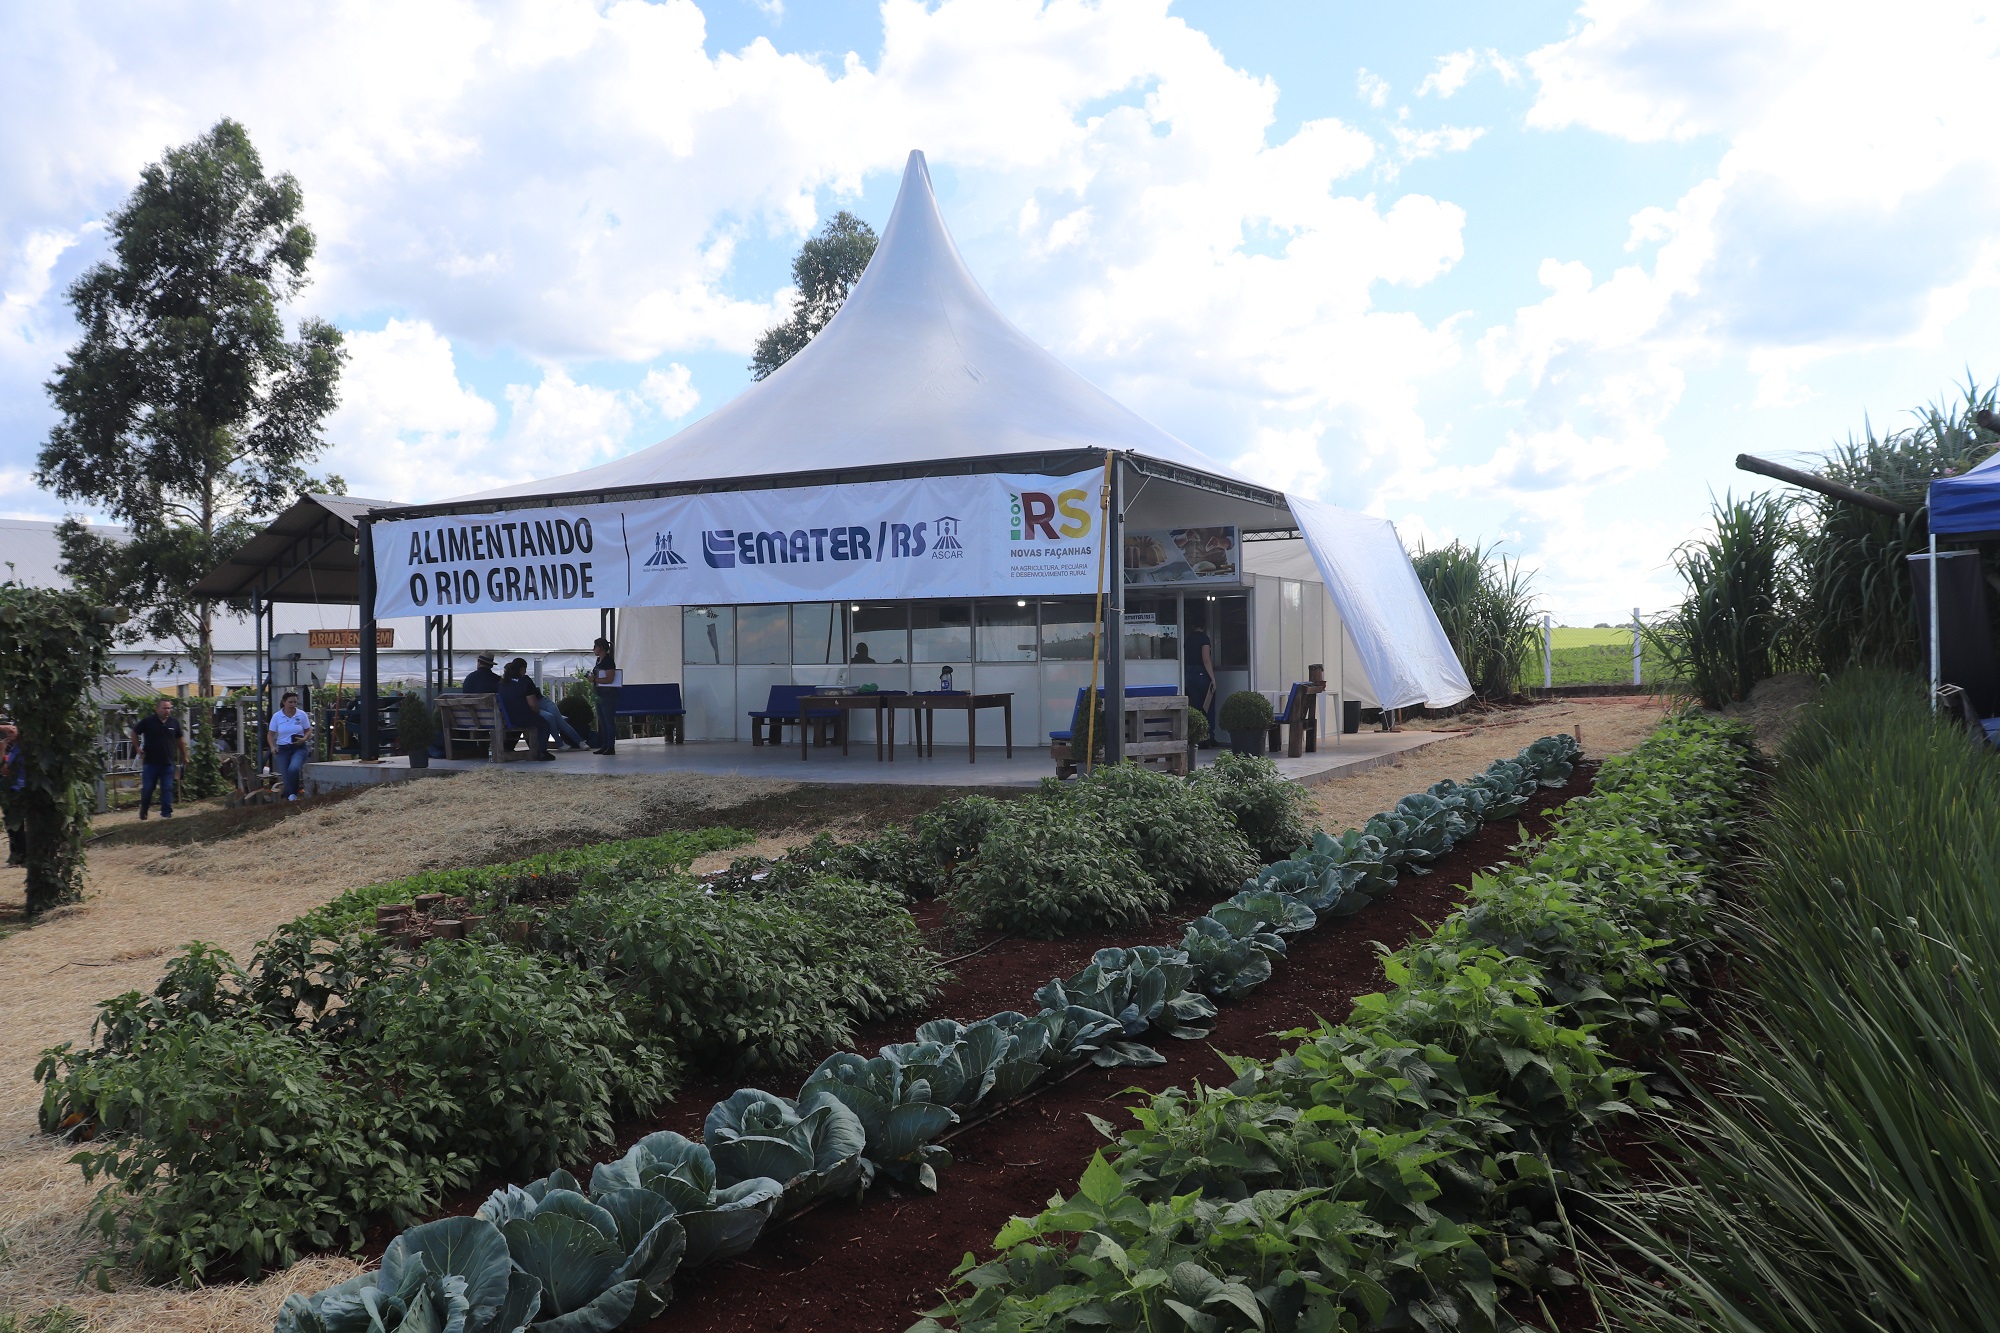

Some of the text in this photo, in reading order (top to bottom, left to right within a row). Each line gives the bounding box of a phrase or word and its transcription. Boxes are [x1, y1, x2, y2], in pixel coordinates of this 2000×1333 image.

[1010, 493, 1021, 527] GOV
[1021, 489, 1091, 540] RS
[408, 517, 594, 566] ALIMENTANDO
[932, 550, 964, 560] ASCAR
[1010, 546, 1092, 559] NOVAS FAÇANHAS
[409, 562, 595, 606] O RIO GRANDE
[311, 631, 390, 645] ARMAZENEM
